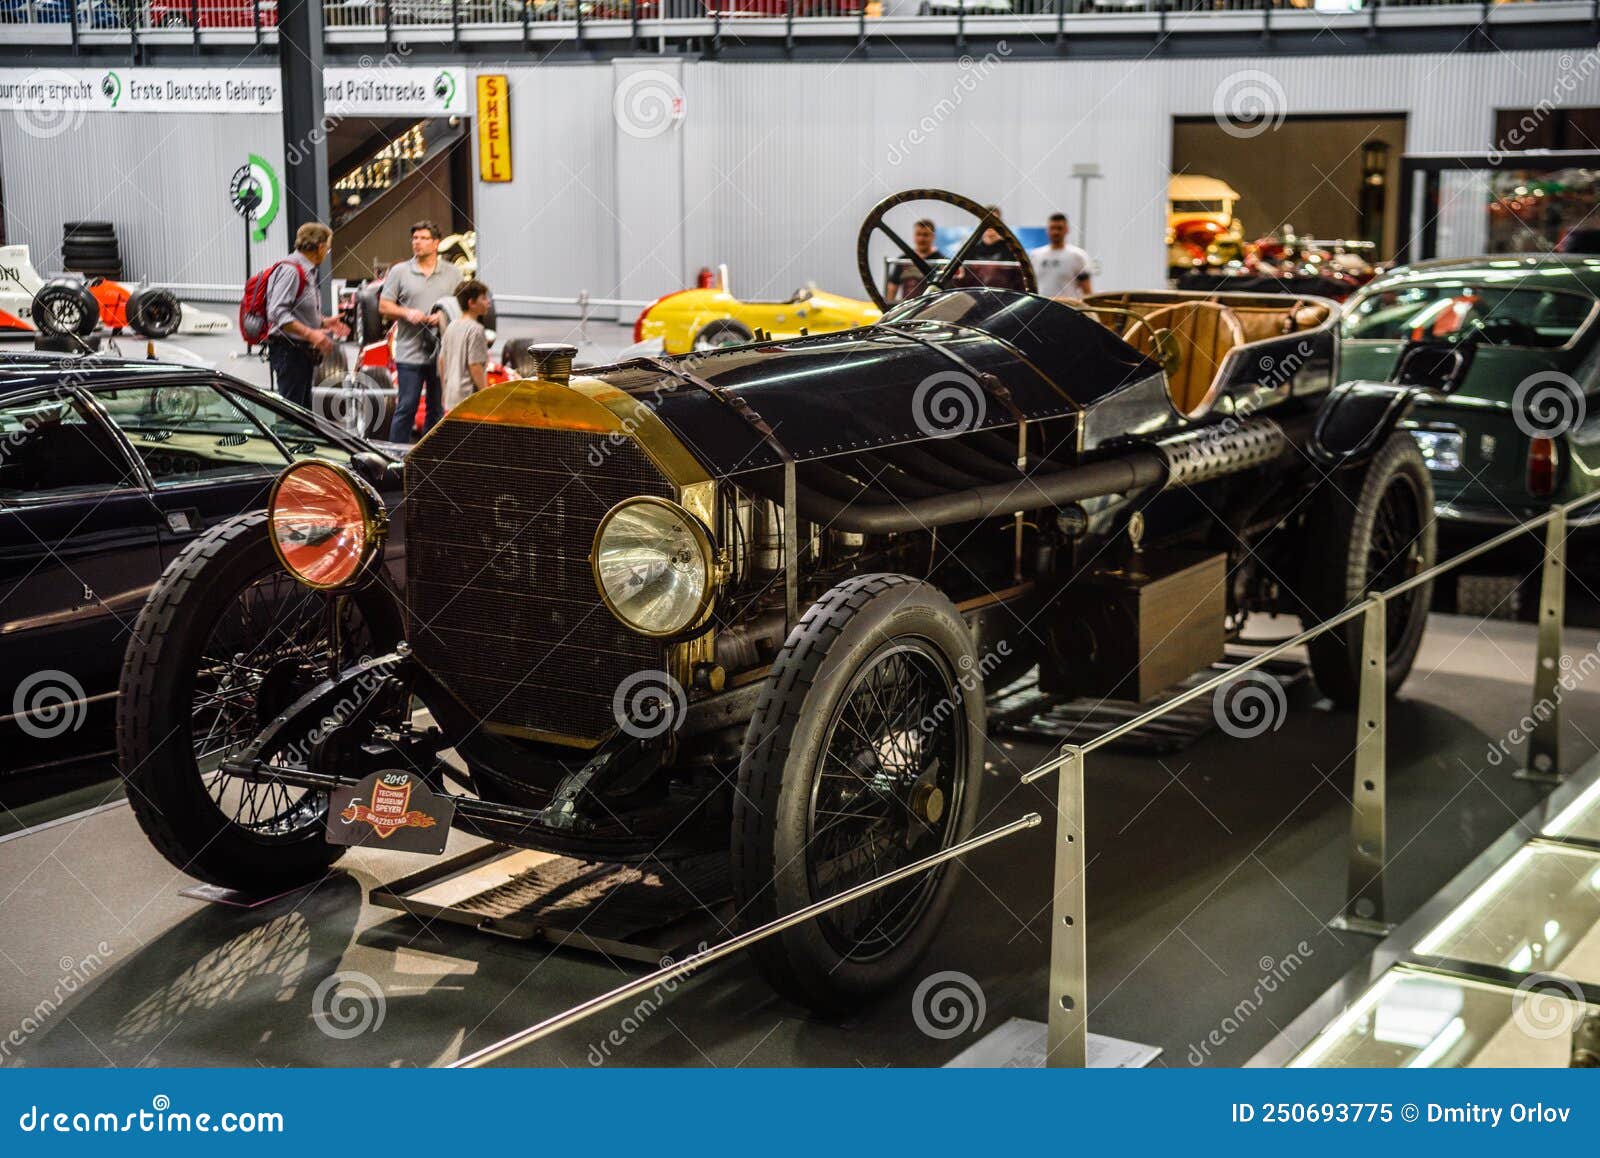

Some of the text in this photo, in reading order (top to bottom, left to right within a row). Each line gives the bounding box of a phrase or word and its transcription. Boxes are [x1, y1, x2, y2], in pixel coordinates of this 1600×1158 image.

[130, 80, 277, 105] Erste Deutsche Gebirgs-
[347, 80, 425, 101] Prüfstrecke
[486, 79, 501, 178] SHELL
[383, 773, 408, 786] 2019
[379, 789, 404, 798] TECHNIK
[377, 797, 404, 806] MUSEUM
[375, 805, 402, 814] SPEYER
